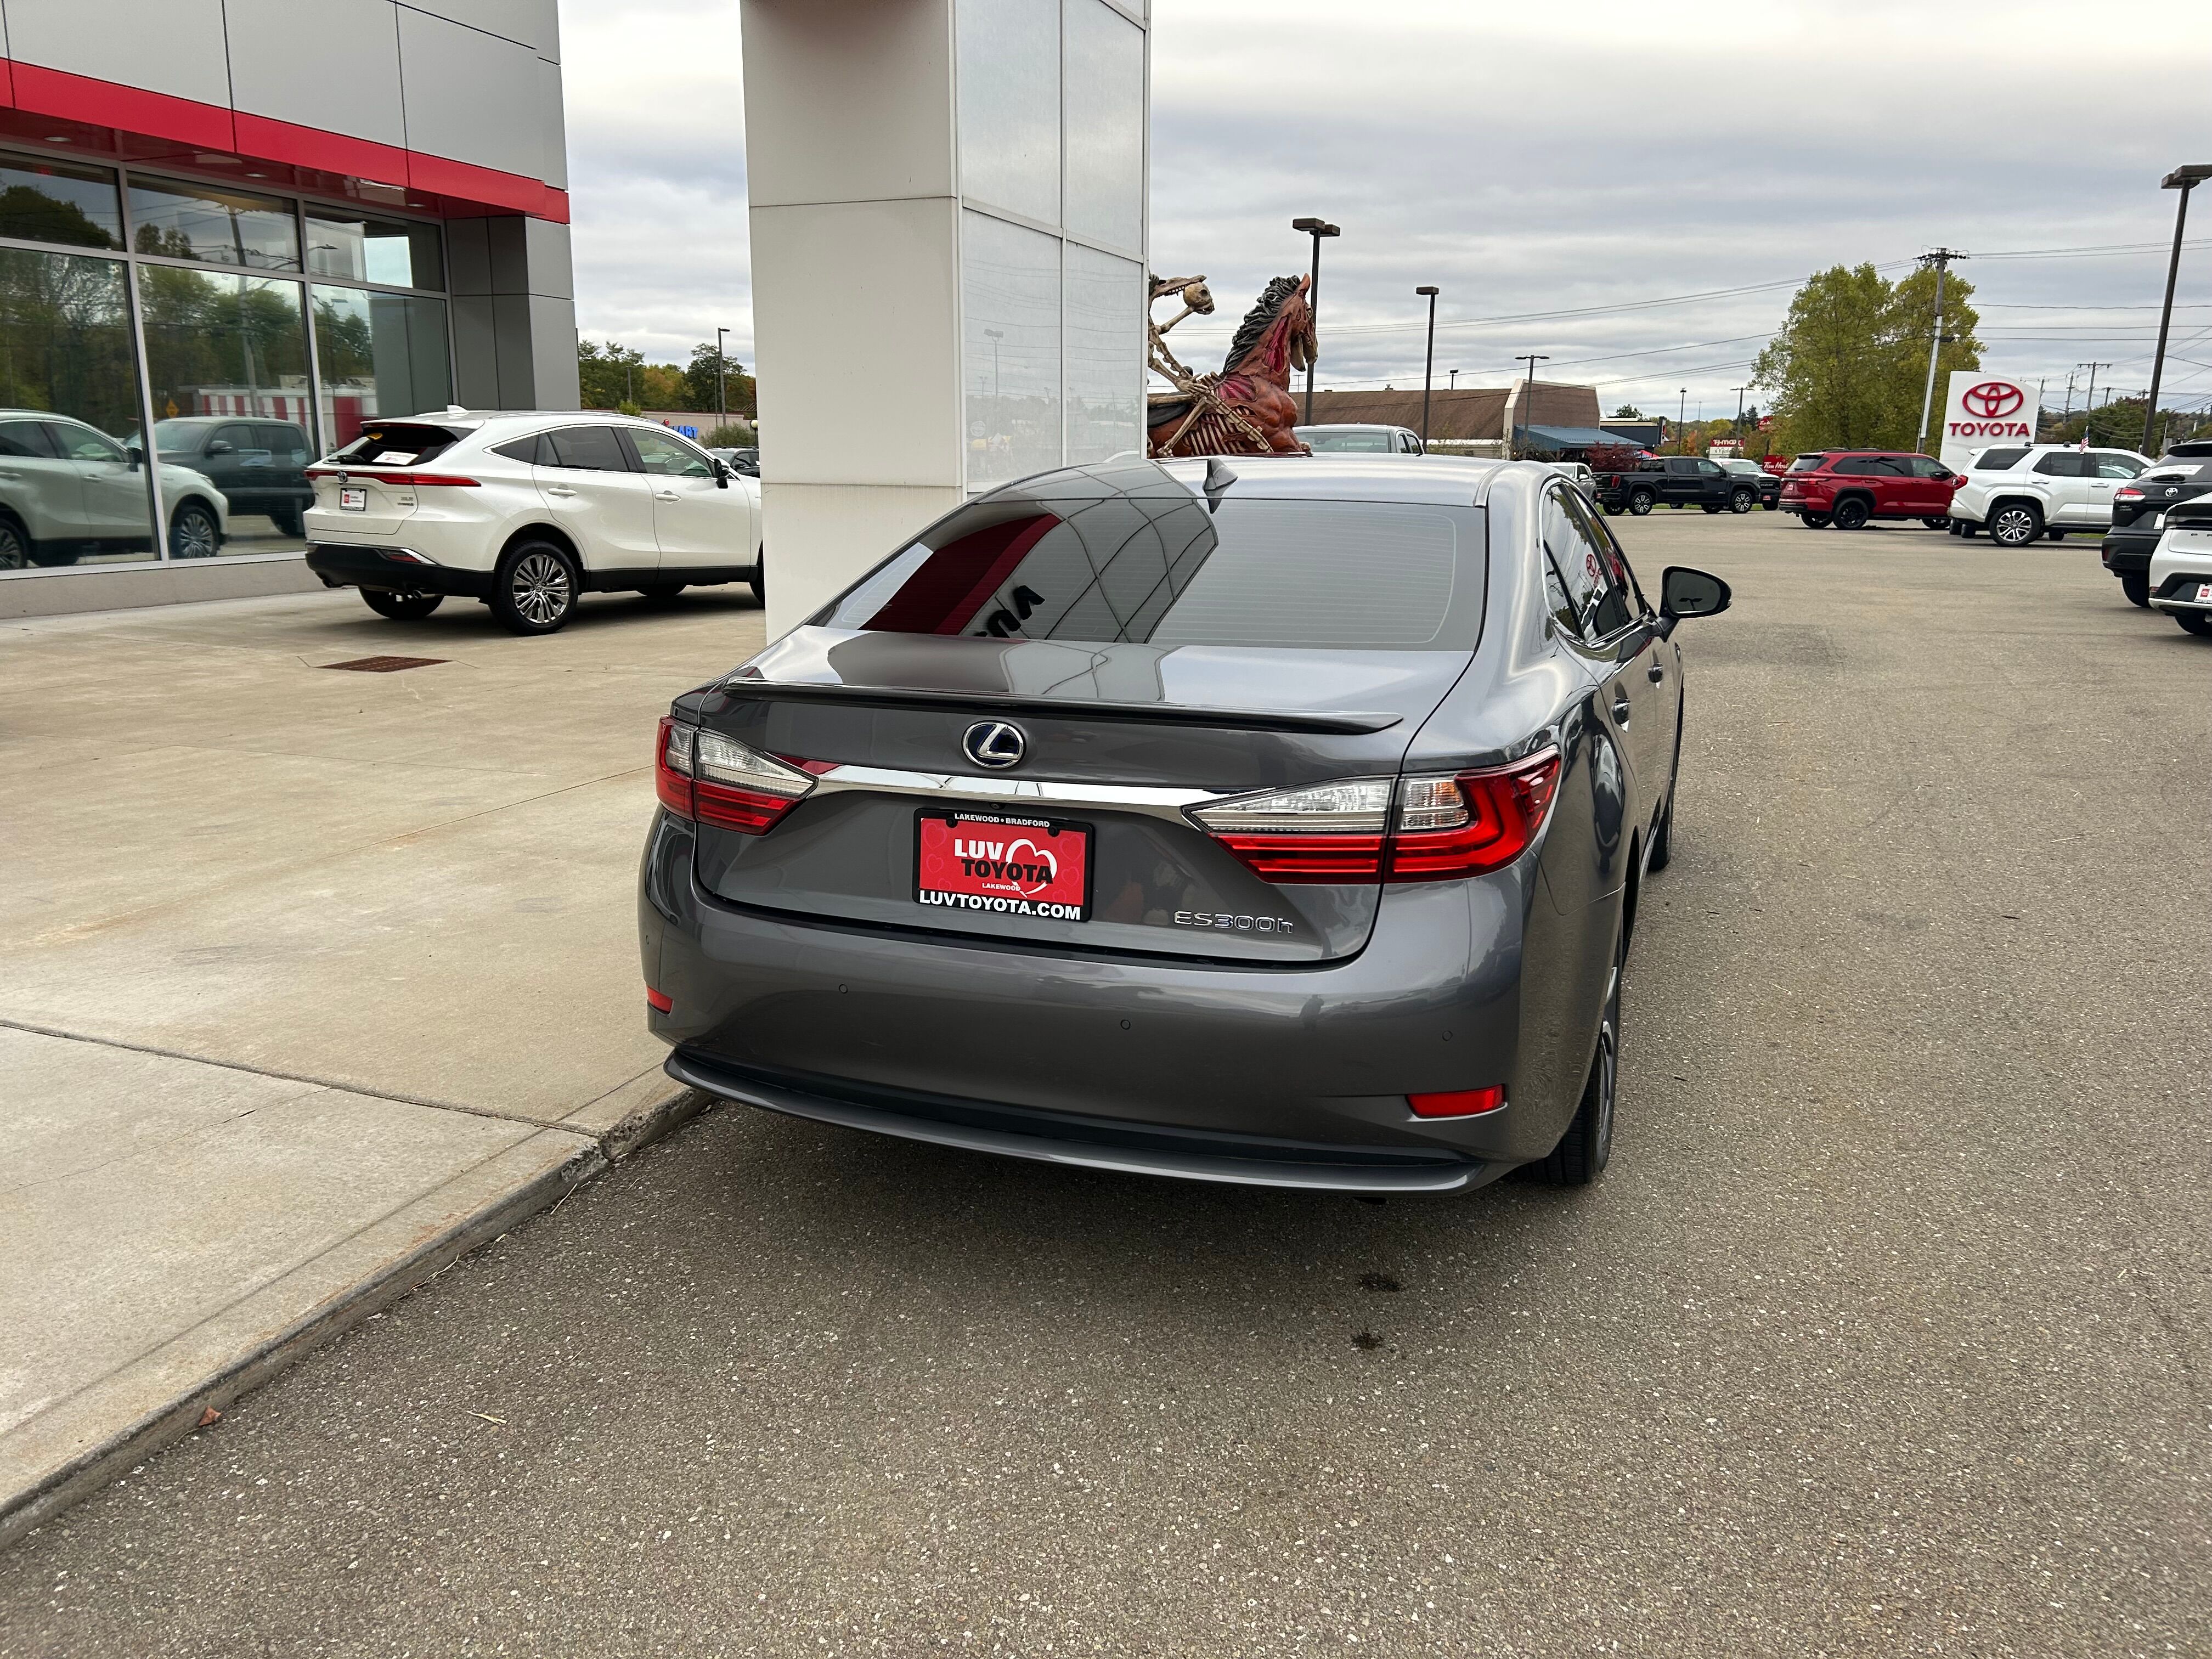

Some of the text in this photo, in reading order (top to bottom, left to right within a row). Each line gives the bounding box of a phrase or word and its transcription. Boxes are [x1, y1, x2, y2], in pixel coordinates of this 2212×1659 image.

[1949, 422, 2030, 436] TOYOTA
[955, 813, 1050, 827] LAKEWOOD BRADFORD
[954, 838, 1004, 860] LUV
[961, 858, 1053, 884] TOYOTA
[981, 882, 1021, 891] LAKEWOOD
[919, 890, 1081, 921] LUVTOYOTA.COM
